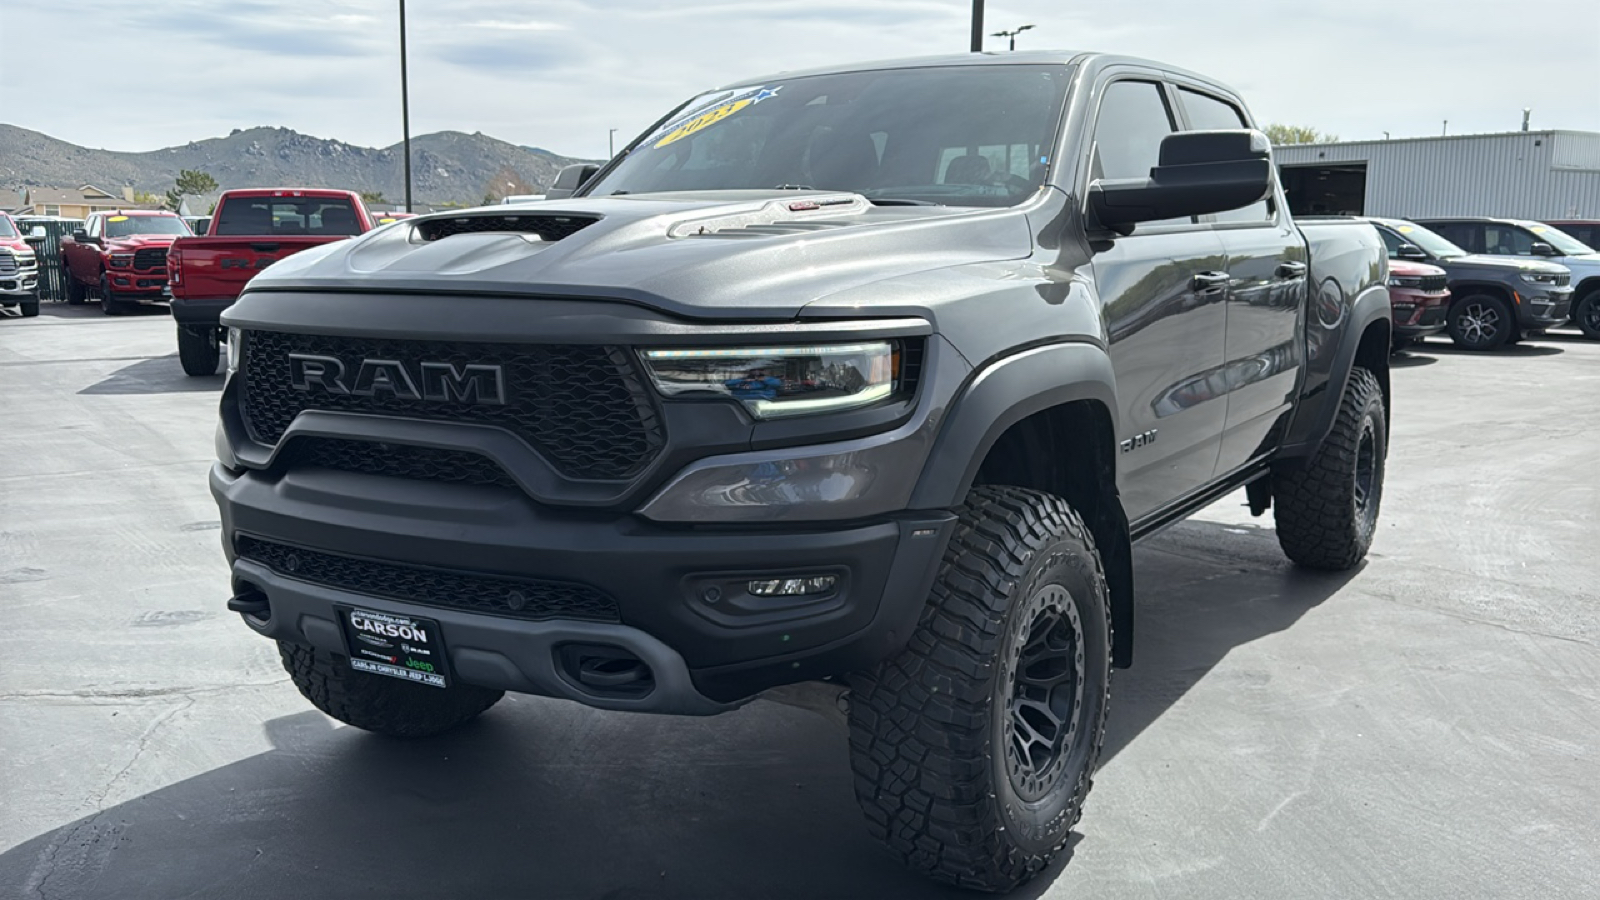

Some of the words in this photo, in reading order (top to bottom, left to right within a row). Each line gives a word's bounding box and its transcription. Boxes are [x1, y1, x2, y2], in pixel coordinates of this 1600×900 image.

[289, 353, 505, 405] RAM
[1120, 428, 1158, 455] RAM
[351, 617, 427, 643] CARSON
[406, 657, 434, 672] Jeep
